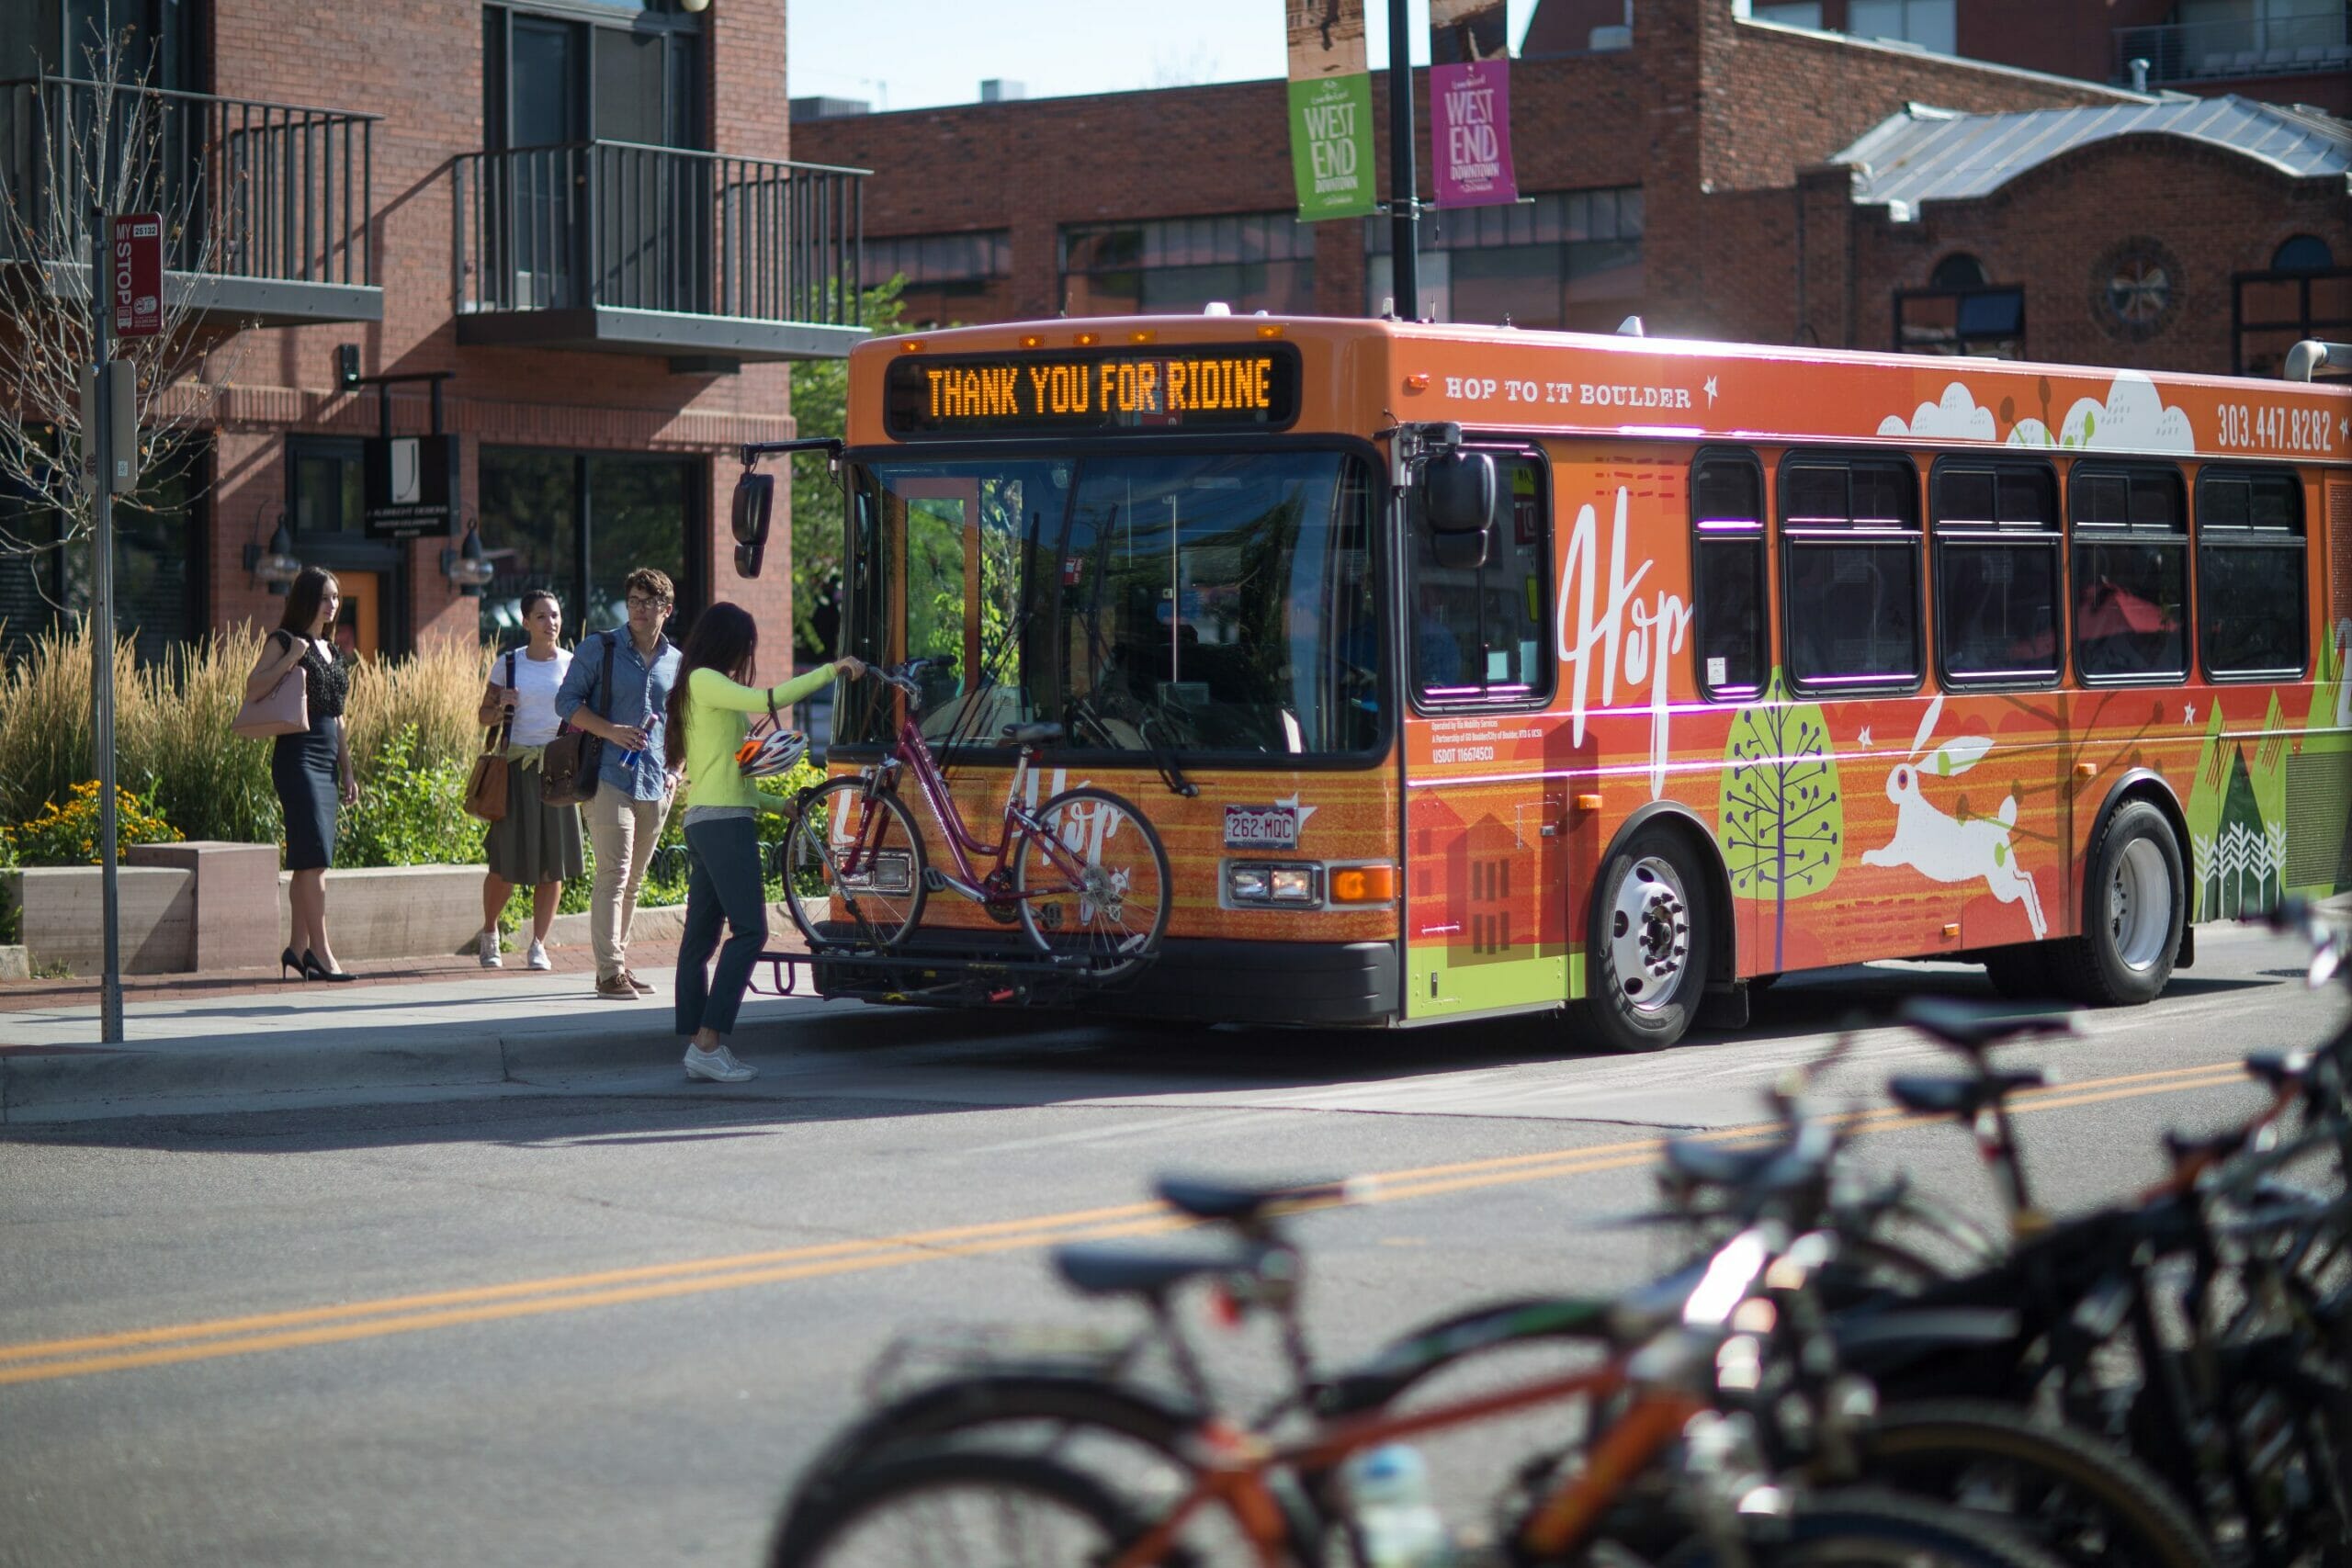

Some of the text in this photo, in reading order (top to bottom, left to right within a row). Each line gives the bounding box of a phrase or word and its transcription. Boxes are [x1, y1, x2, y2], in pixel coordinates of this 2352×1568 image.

[1304, 102, 1356, 140] WEST
[1444, 89, 1494, 125] WEST
[1311, 138, 1356, 179] END
[1449, 124, 1498, 164] END
[116, 223, 130, 241] MY
[117, 242, 132, 304] STOP
[928, 367, 1018, 416] THANK
[1031, 366, 1090, 413] YOU
[1102, 364, 1156, 412] FOR
[1445, 378, 1690, 408] HOP TO IT BOULDER
[2218, 403, 2332, 451] 303.447.8282
[1557, 485, 1693, 801] Hop
[1433, 749, 1455, 763] USDOT
